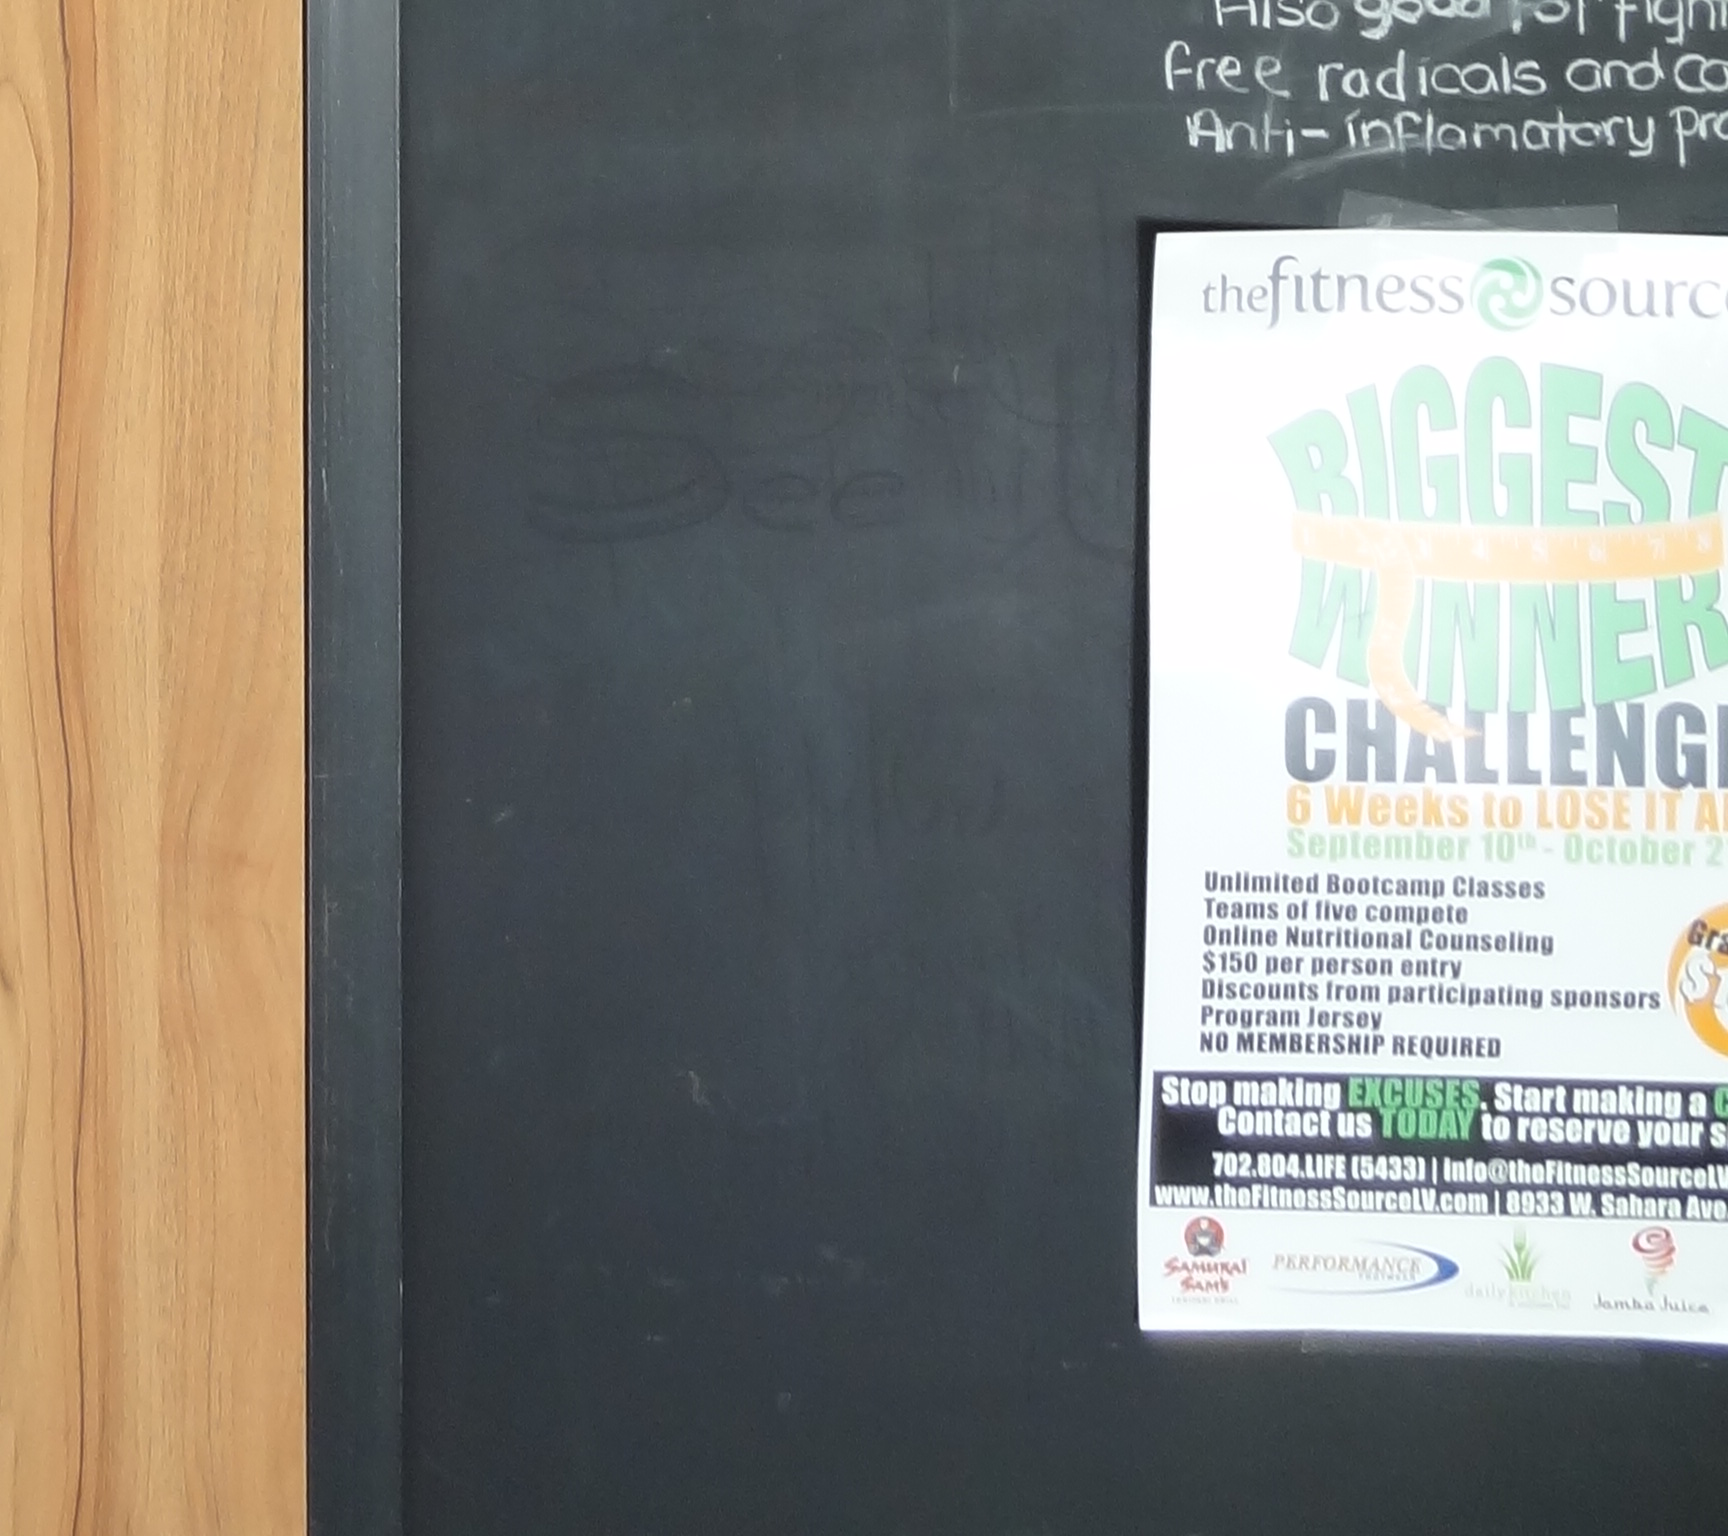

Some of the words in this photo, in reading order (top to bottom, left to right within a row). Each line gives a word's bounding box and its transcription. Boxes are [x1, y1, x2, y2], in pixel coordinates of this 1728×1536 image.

[1164, 38, 1291, 98] free
[1317, 49, 1548, 102] radicals
[1566, 47, 1665, 95] and
[1284, 696, 1728, 790] CHALLENG
[1286, 785, 1312, 826] 6
[1325, 787, 1470, 830] Weeks
[1482, 789, 1525, 830] to
[1536, 789, 1632, 831] LOSE
[1644, 790, 1683, 832] IT
[1287, 829, 1471, 864] September
[1563, 833, 1695, 867] October
[1203, 870, 1320, 896] Unlimited
[1325, 872, 1446, 900] Bootcamp
[1452, 874, 1547, 900] Classes
[1203, 897, 1279, 921] Teams
[1286, 898, 1309, 922] of
[1314, 898, 1358, 923] five
[1364, 902, 1469, 927] compete
[1202, 924, 1279, 948] Online
[1285, 925, 1413, 950] Nutritional
[1419, 928, 1555, 956] Counseling
[1202, 950, 1258, 976] $150
[1265, 957, 1304, 979] per
[1310, 957, 1394, 980] person
[1400, 956, 1462, 982] entry
[1201, 977, 1319, 1002] Discounts
[1324, 979, 1380, 1005] from
[1386, 981, 1544, 1011] participating
[1550, 988, 1662, 1012] sponsors
[1200, 1004, 1301, 1032] Program
[1307, 1007, 1383, 1032] Jersey
[1199, 1032, 1229, 1054] NO
[1235, 1033, 1386, 1057] MEMBERSHIP
[1392, 1035, 1502, 1060] REQUIRED
[1161, 1076, 1226, 1111] Stop
[1232, 1076, 1342, 1112] making
[1494, 1082, 1566, 1114] Start
[1572, 1084, 1683, 1119] making
[1688, 1090, 1707, 1118] a
[1217, 1106, 1332, 1137] Contact
[1337, 1112, 1373, 1137] us
[1378, 1108, 1474, 1141] TODAY
[1480, 1112, 1511, 1142] to
[1517, 1116, 1631, 1145] reserve
[1636, 1119, 1704, 1149] your
